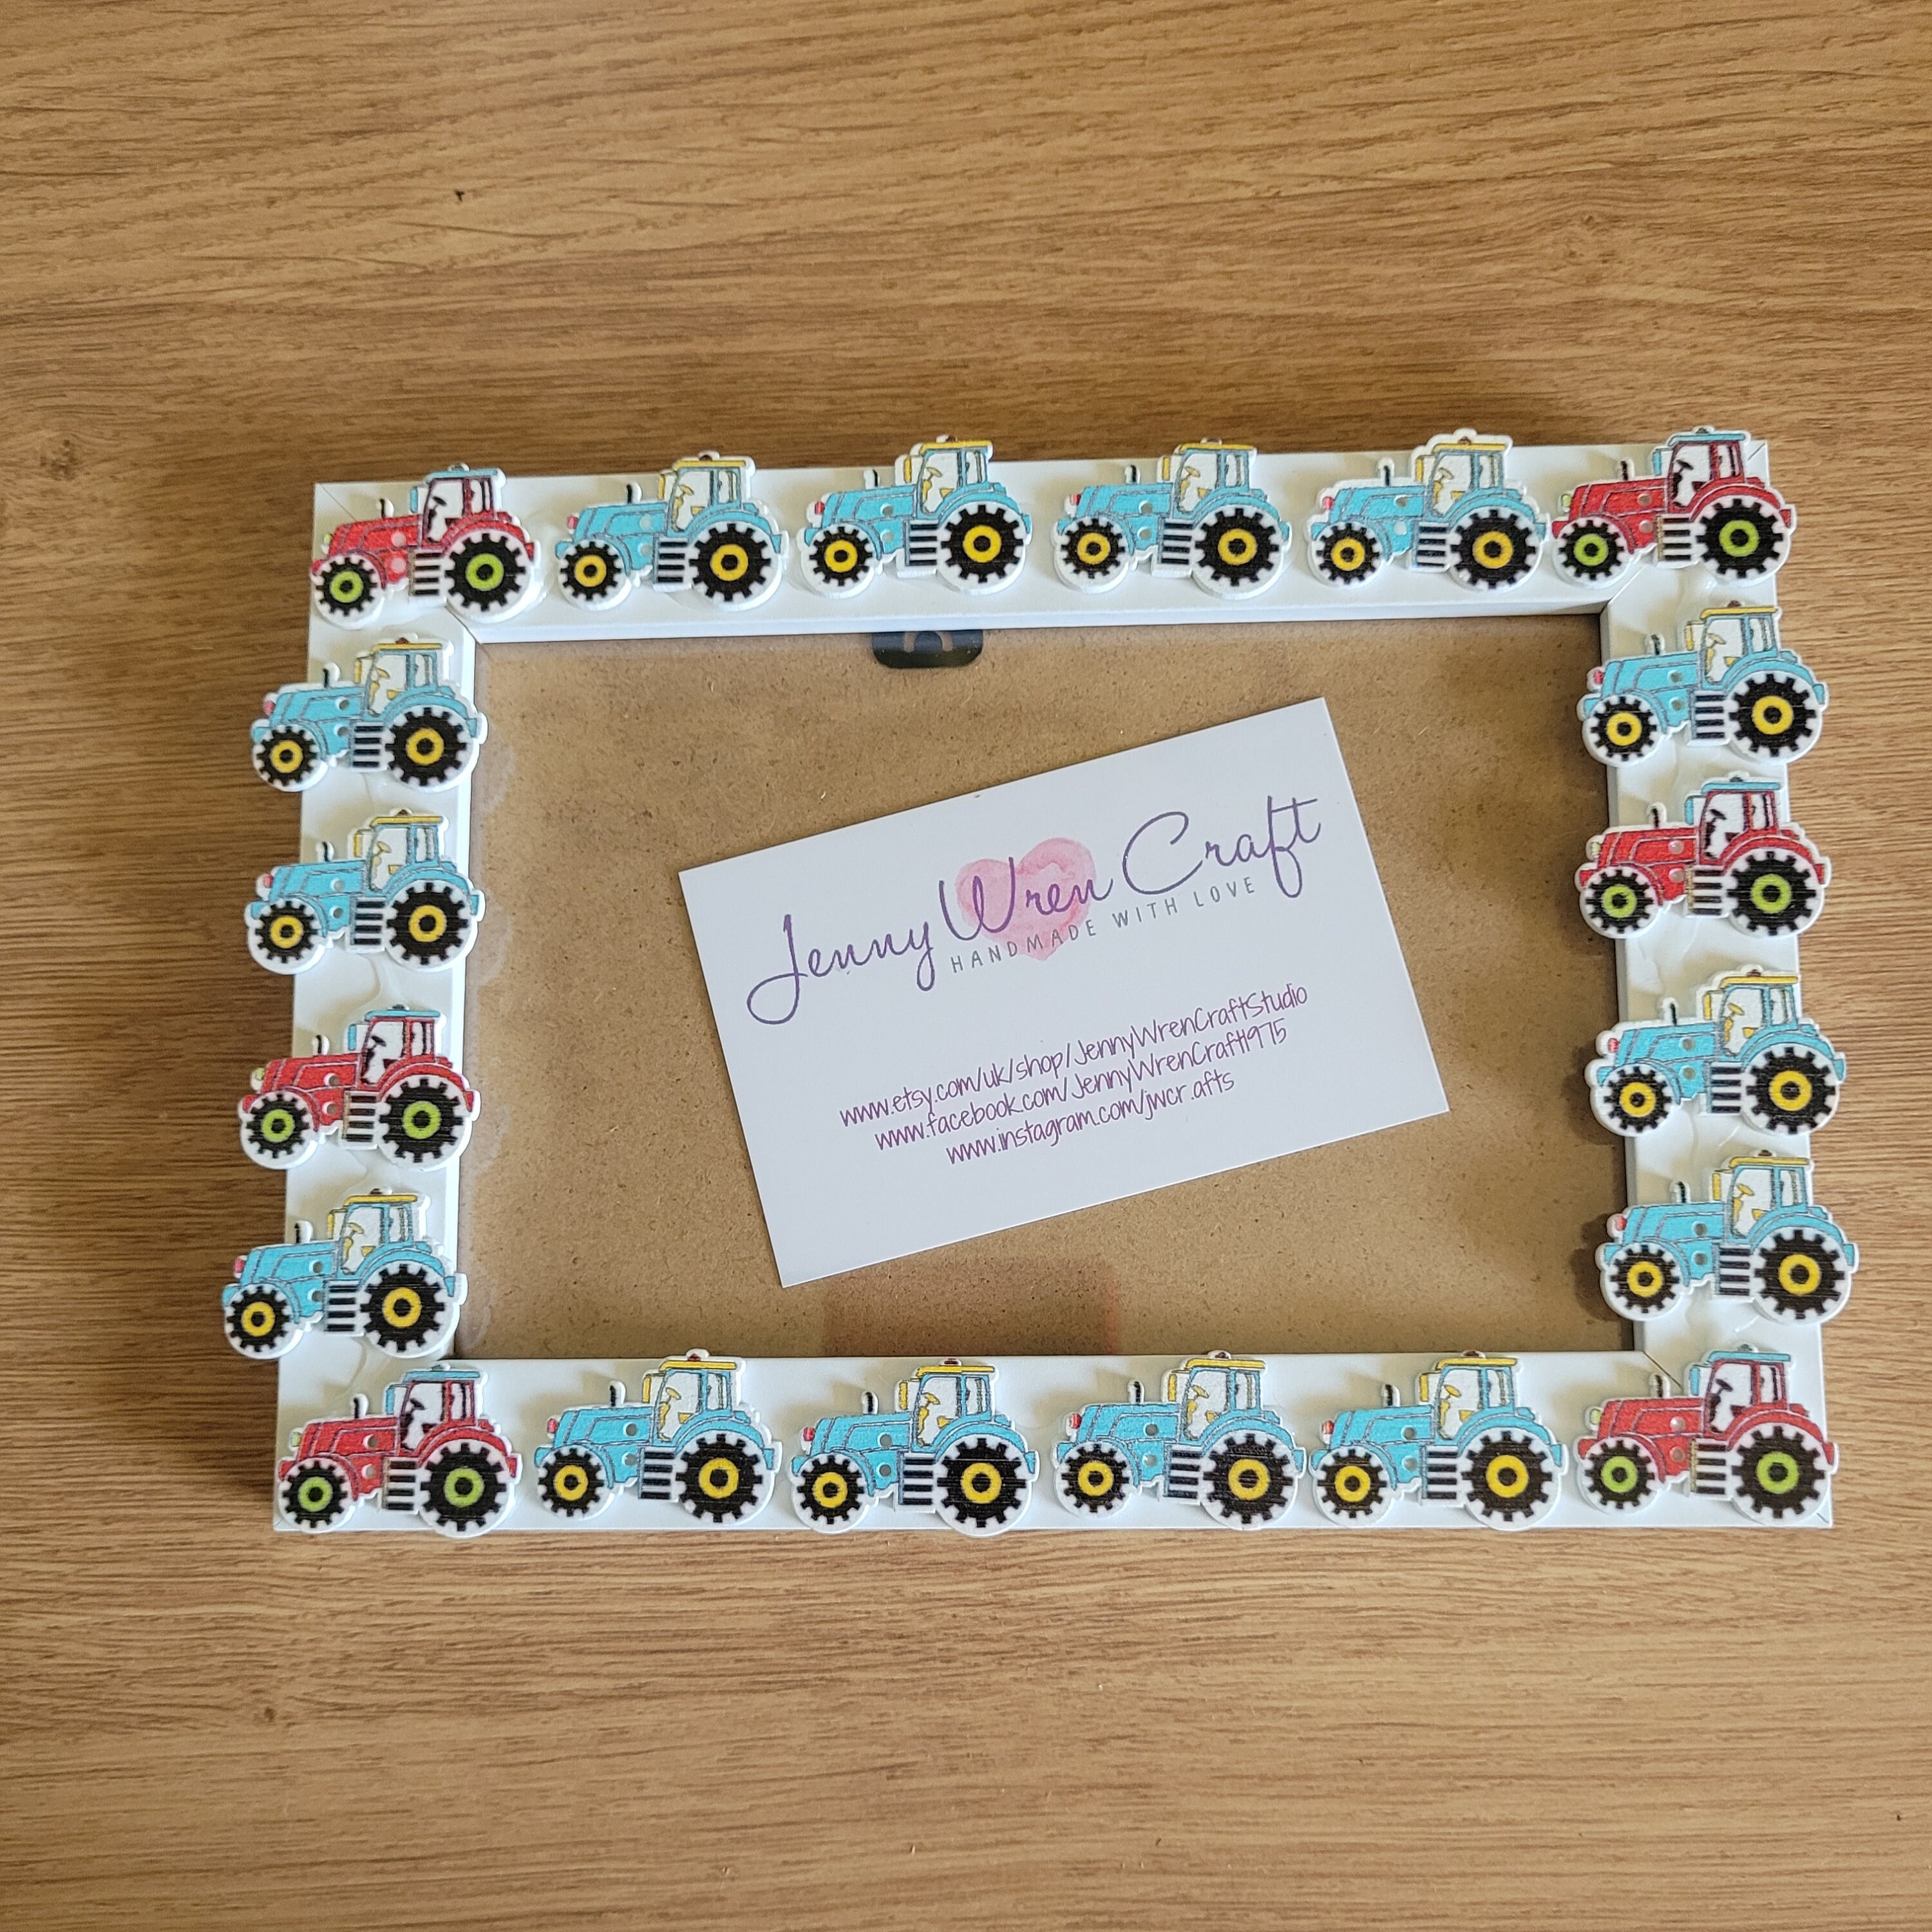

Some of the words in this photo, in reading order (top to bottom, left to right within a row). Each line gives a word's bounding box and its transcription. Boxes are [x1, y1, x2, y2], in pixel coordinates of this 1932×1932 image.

[746, 913, 936, 1025] Jenny
[938, 857, 1114, 942] Wren
[1122, 795, 1321, 898] Craft
[950, 919, 1097, 974] HANDMADE
[1112, 897, 1178, 929] WITH
[1193, 876, 1255, 907] LOVE
[839, 983, 1308, 1128] www.etsy.com/uk/shop/JennyWrenCraftStudio
